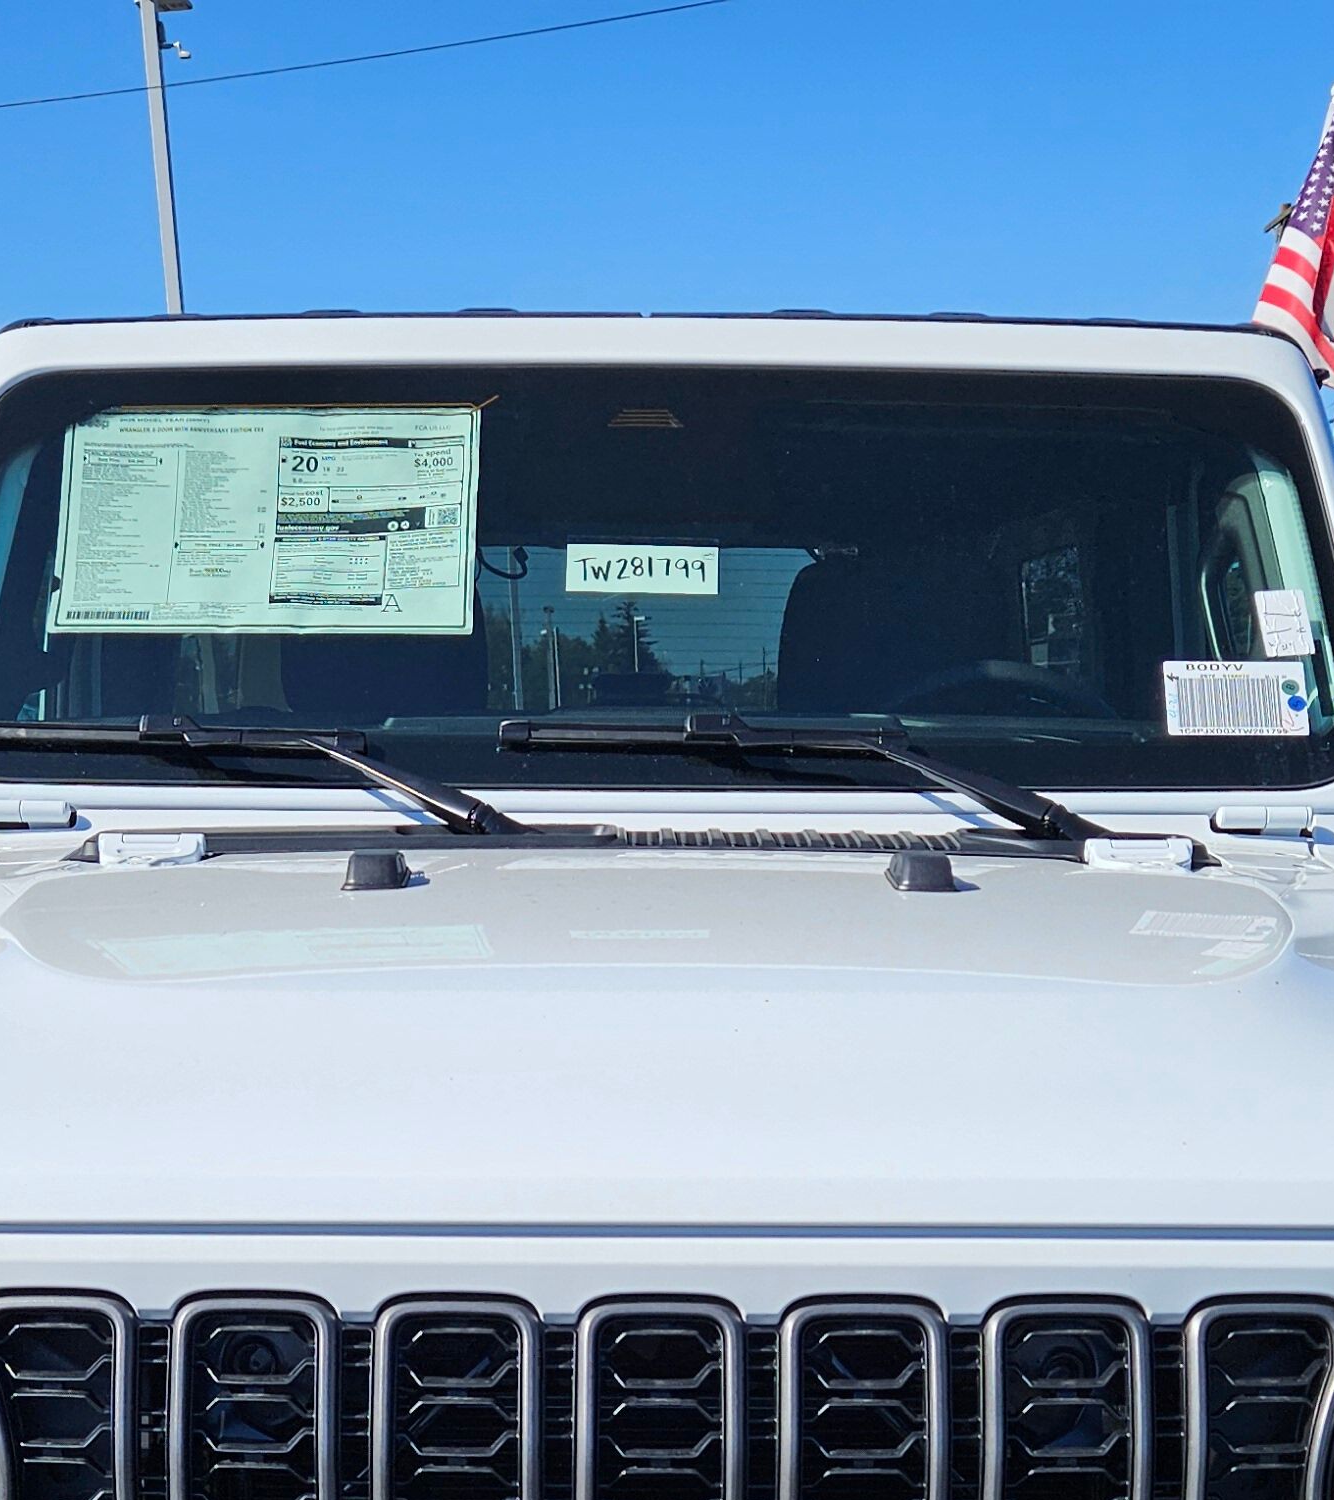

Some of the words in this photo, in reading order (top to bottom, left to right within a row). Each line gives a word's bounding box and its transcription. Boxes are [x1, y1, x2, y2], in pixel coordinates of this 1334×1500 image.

[294, 438, 308, 446] Fuel
[309, 438, 336, 447] Economy
[337, 438, 349, 446] and
[426, 448, 451, 458] spend
[291, 455, 319, 473] 20
[414, 457, 453, 468] $4,000
[281, 496, 321, 508] $2,500
[573, 556, 706, 583] TW281799
[381, 593, 403, 613] A
[1186, 663, 1244, 671] BODYV
